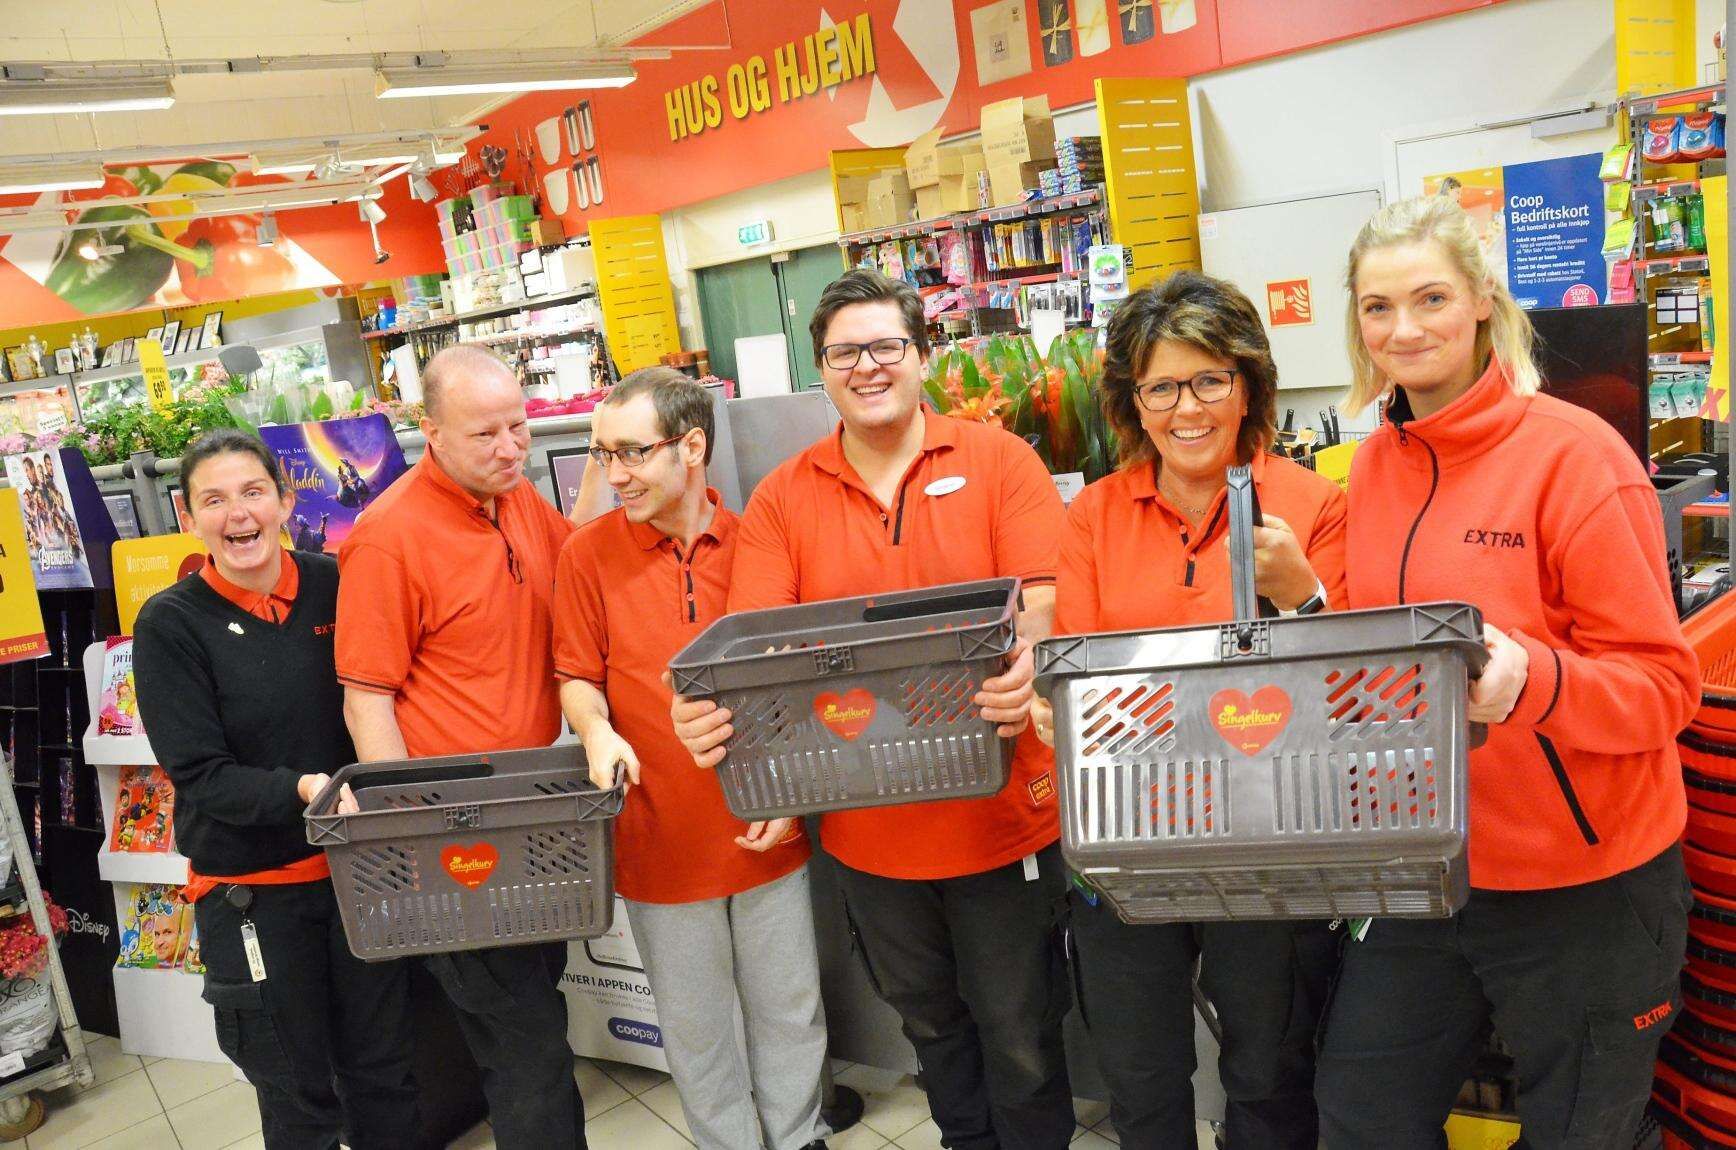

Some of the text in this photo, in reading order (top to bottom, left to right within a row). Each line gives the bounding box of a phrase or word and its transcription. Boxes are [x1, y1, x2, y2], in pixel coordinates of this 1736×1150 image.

[664, 12, 876, 142] HUS OG HJEM
[1510, 195, 1544, 208] Coop
[1511, 204, 1590, 224] Bedriftskort
[1570, 288, 1590, 296] SEND
[1572, 295, 1588, 303] SMS
[279, 456, 326, 493] Aladdin
[1463, 529, 1526, 548] EXTRA
[8, 641, 39, 655] PRISER
[824, 705, 871, 723] Singelkurv
[1218, 707, 1282, 730] Singelkurv
[1032, 777, 1049, 791] coop
[449, 858, 493, 873] Singelkurv
[65, 908, 110, 944] Disney
[597, 977, 632, 991] APPEN
[1633, 1000, 1673, 1030] EXTRA
[615, 1024, 659, 1042] coopay
